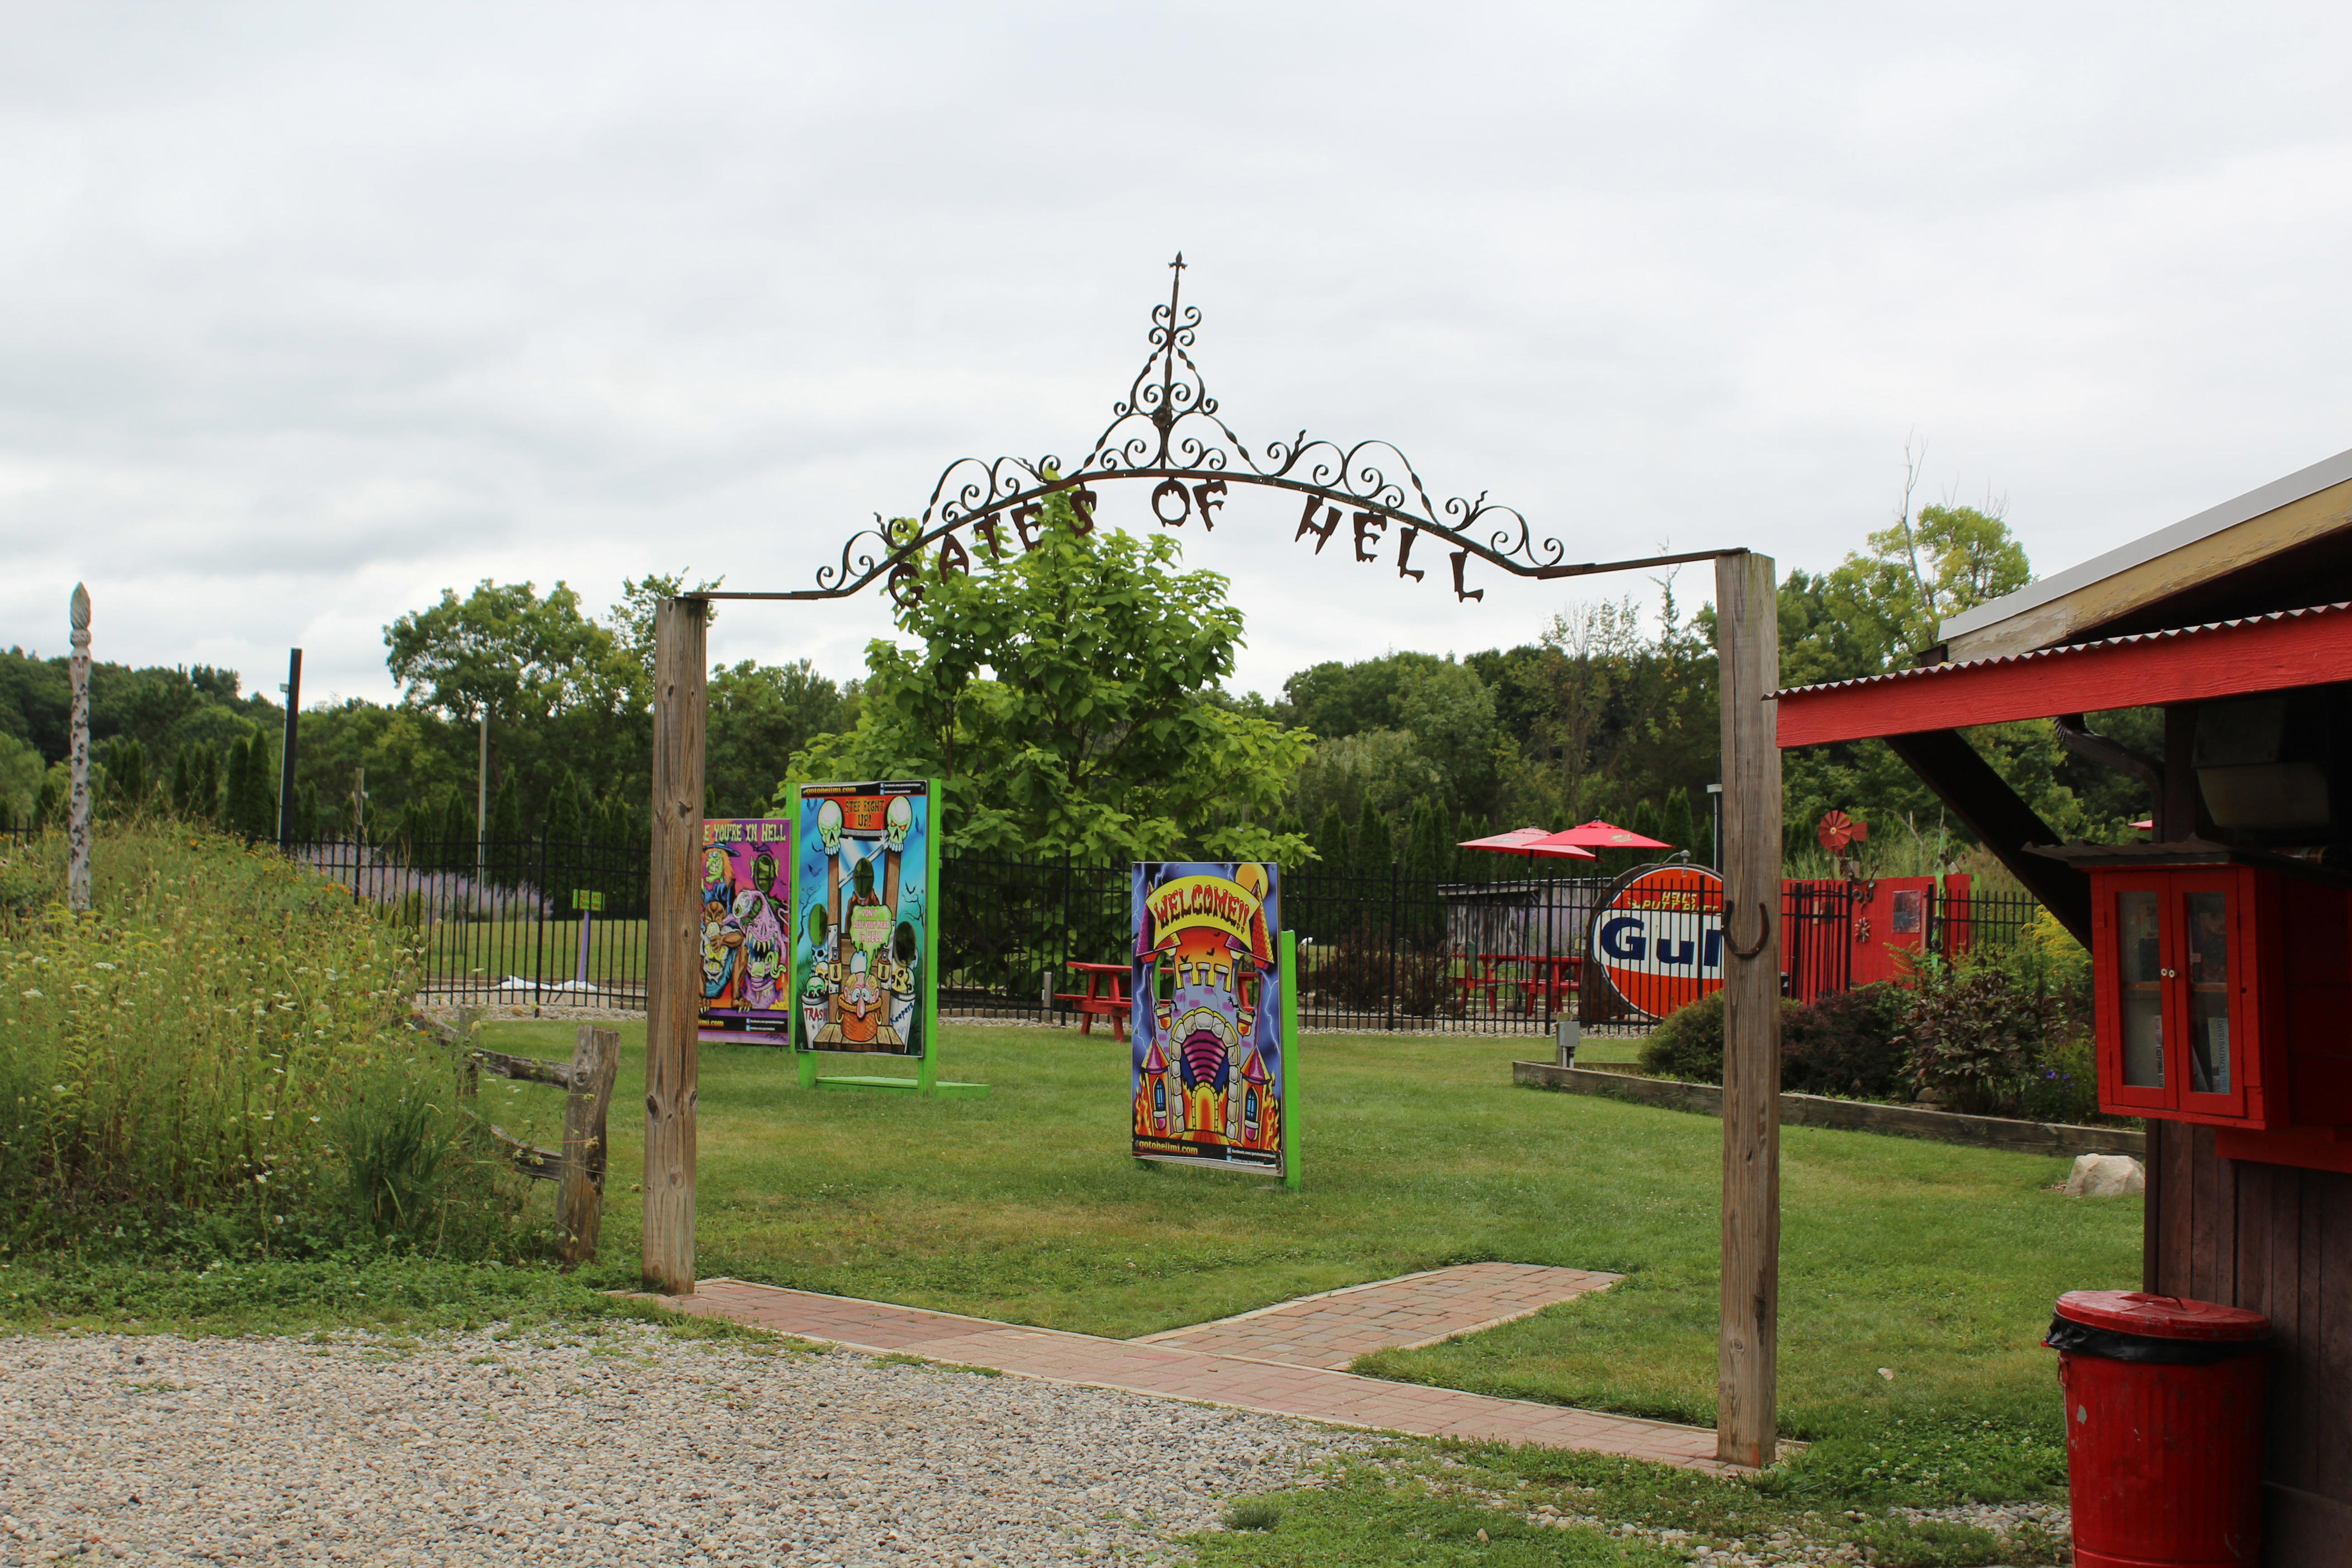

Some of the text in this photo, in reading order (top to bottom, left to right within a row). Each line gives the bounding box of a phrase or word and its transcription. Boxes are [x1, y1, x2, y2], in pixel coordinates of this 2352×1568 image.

[888, 480, 1484, 608] GATES OF HELL
[845, 800, 884, 813] STEP RIGHT
[858, 814, 871, 827] UP!
[714, 823, 742, 842] YOU'RE
[745, 823, 758, 842] IN
[761, 823, 786, 842] HELL
[1661, 891, 1698, 904] HELL'S
[1154, 884, 1250, 934] WELCOME!!
[1642, 900, 1679, 910] PUTT
[867, 931, 884, 943] HELL
[1602, 917, 1722, 967] Gul
[804, 1008, 828, 1022] TRASH
[890, 1002, 914, 1025] Keepers
[1139, 1140, 1198, 1155] gotohellmi.com
